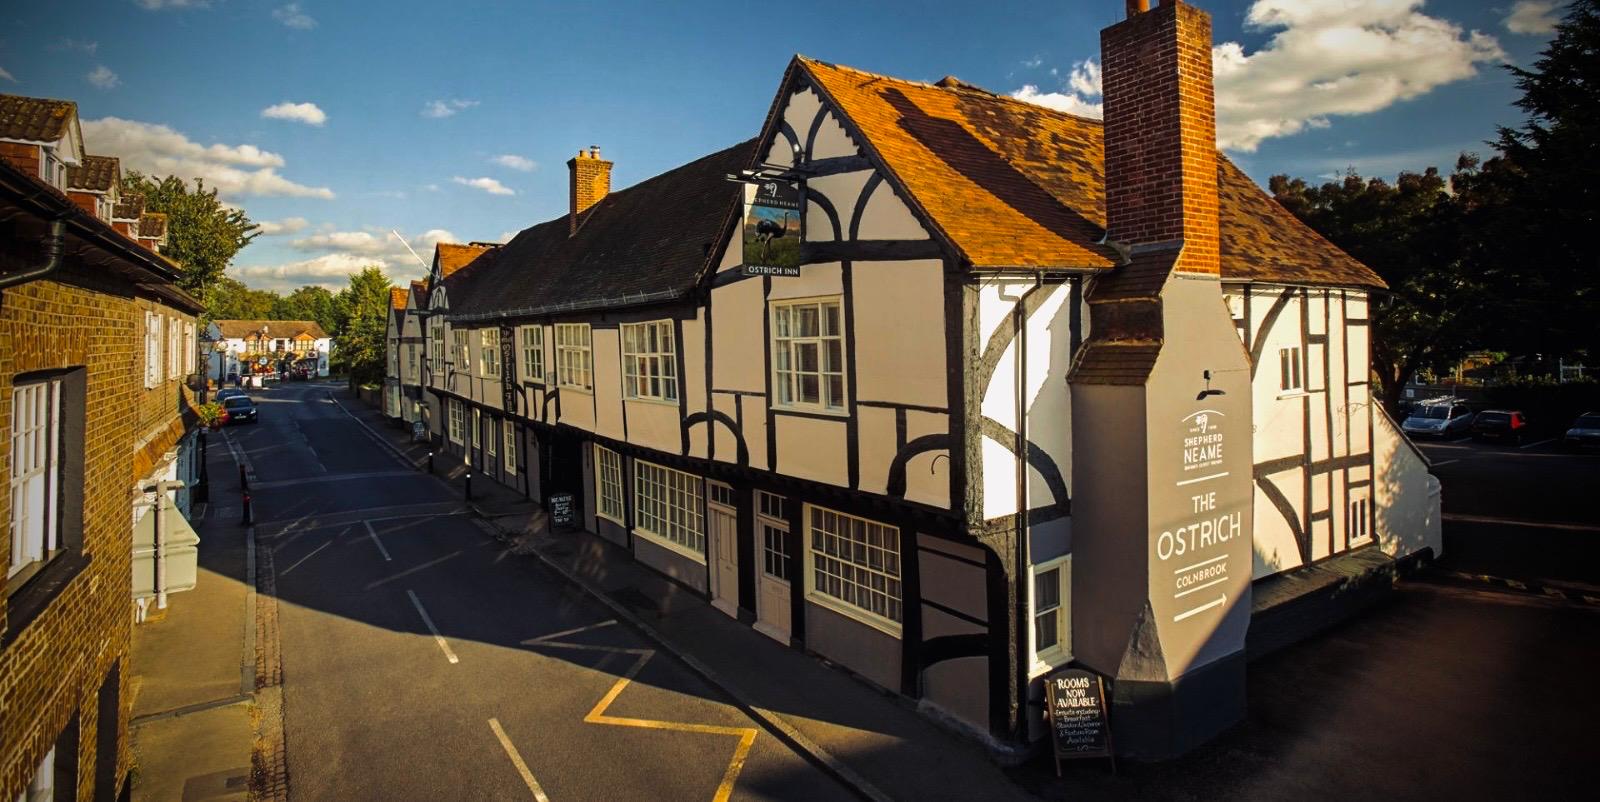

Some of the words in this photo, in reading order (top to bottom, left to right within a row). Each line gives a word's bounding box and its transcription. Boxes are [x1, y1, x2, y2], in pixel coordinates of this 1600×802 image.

[748, 265, 782, 275] OSTRICH
[785, 267, 798, 275] INN
[1184, 433, 1223, 447] SHEPHERD
[1184, 443, 1223, 464] NEAME
[1192, 492, 1216, 514] THE
[1157, 511, 1241, 560] OSTRICH
[1176, 562, 1227, 589] COLNBROOK
[1057, 677, 1090, 689] ROOMS
[1066, 688, 1086, 698] NOW
[1056, 697, 1096, 708] AVAILABLE
